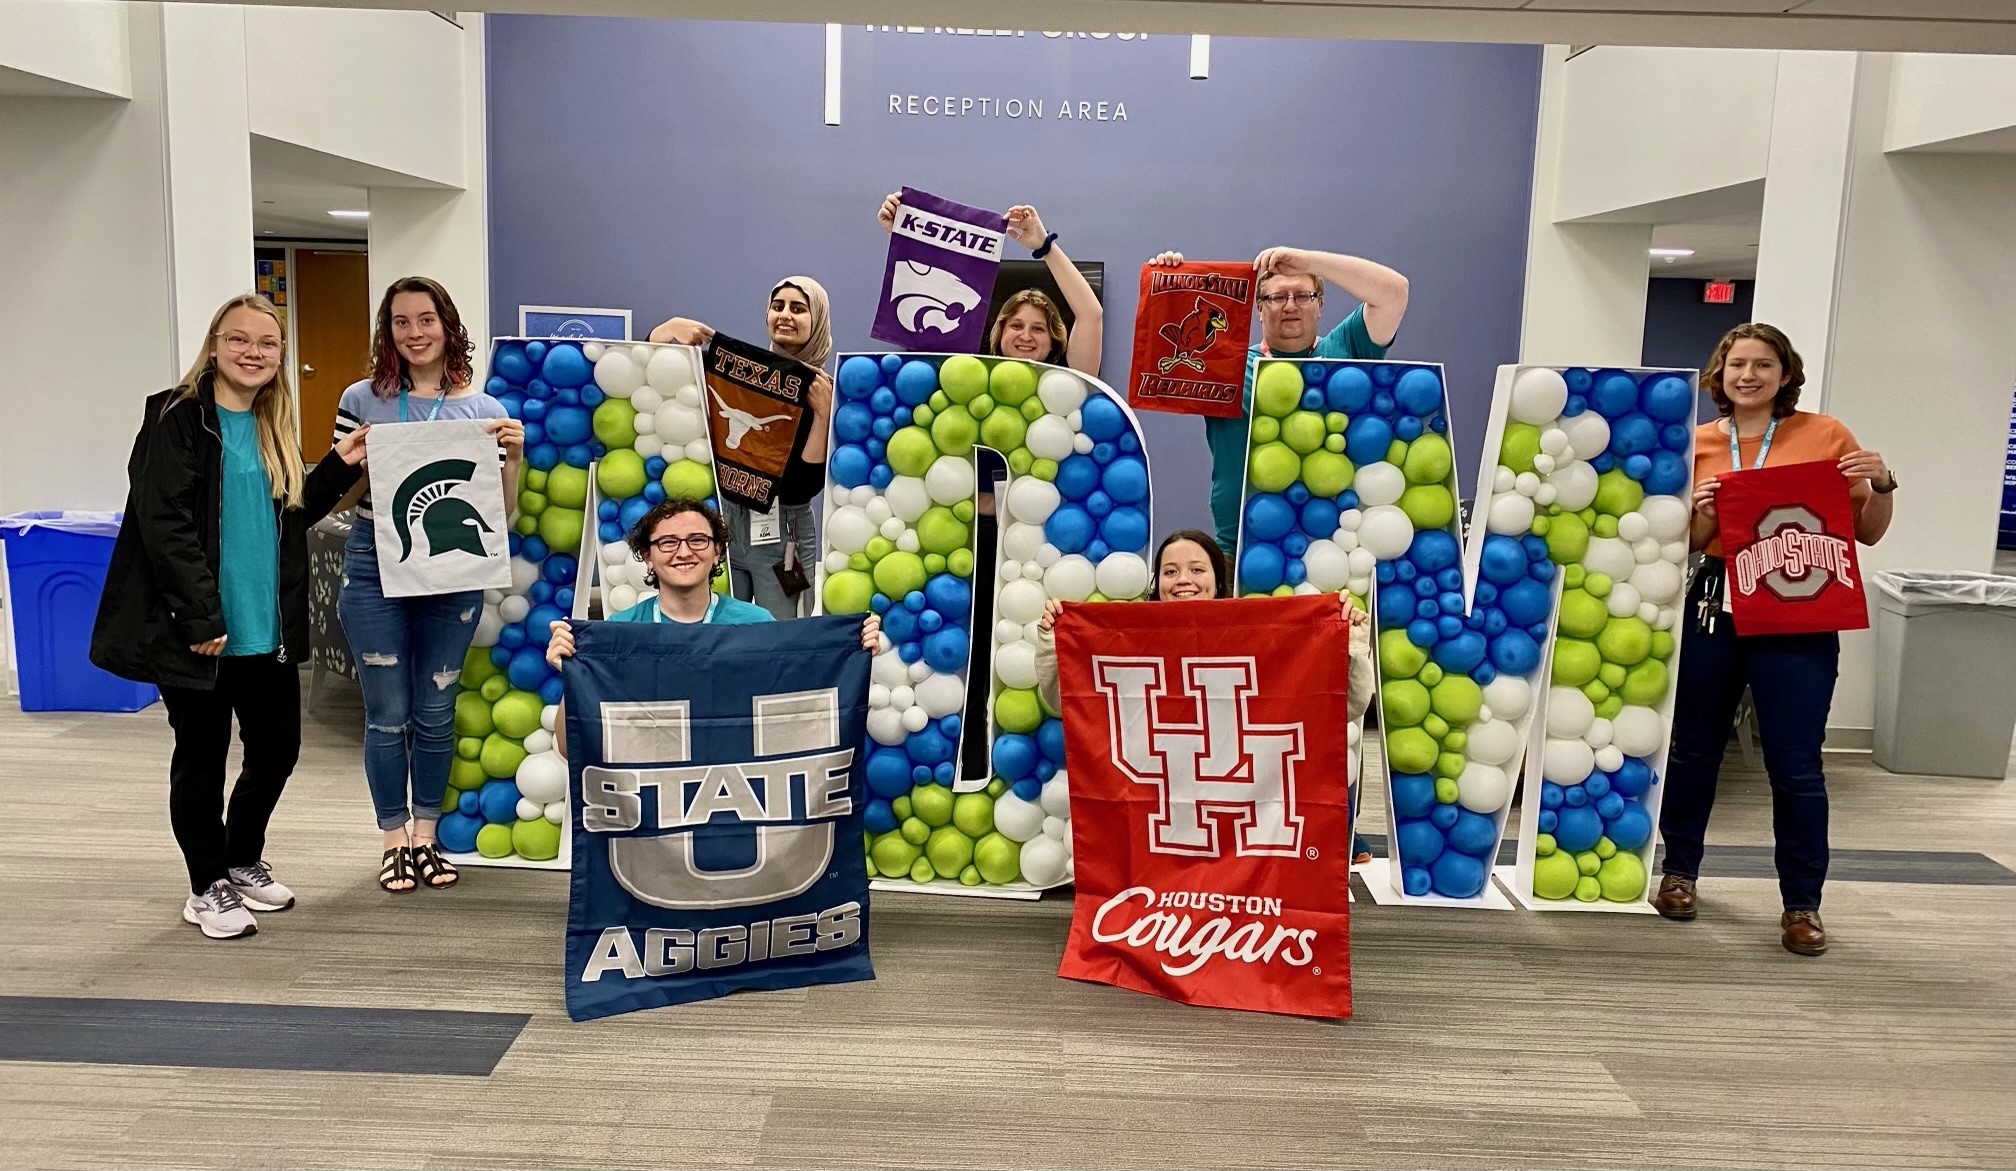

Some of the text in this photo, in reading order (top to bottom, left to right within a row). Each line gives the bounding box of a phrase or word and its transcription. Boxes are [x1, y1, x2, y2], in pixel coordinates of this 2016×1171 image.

[888, 94, 1128, 121] RECEPTION AREA
[900, 213, 997, 254] K-STATE
[1151, 271, 1249, 304] ILLINOIS STATE
[715, 347, 801, 399] TEXAS
[1138, 373, 1238, 403] REDBIRDS
[1091, 654, 1305, 858] UH
[582, 747, 855, 833] STATE
[1157, 892, 1282, 917] HOUSTON
[581, 901, 861, 983] AGGIES
[1091, 886, 1318, 977] Cougars
